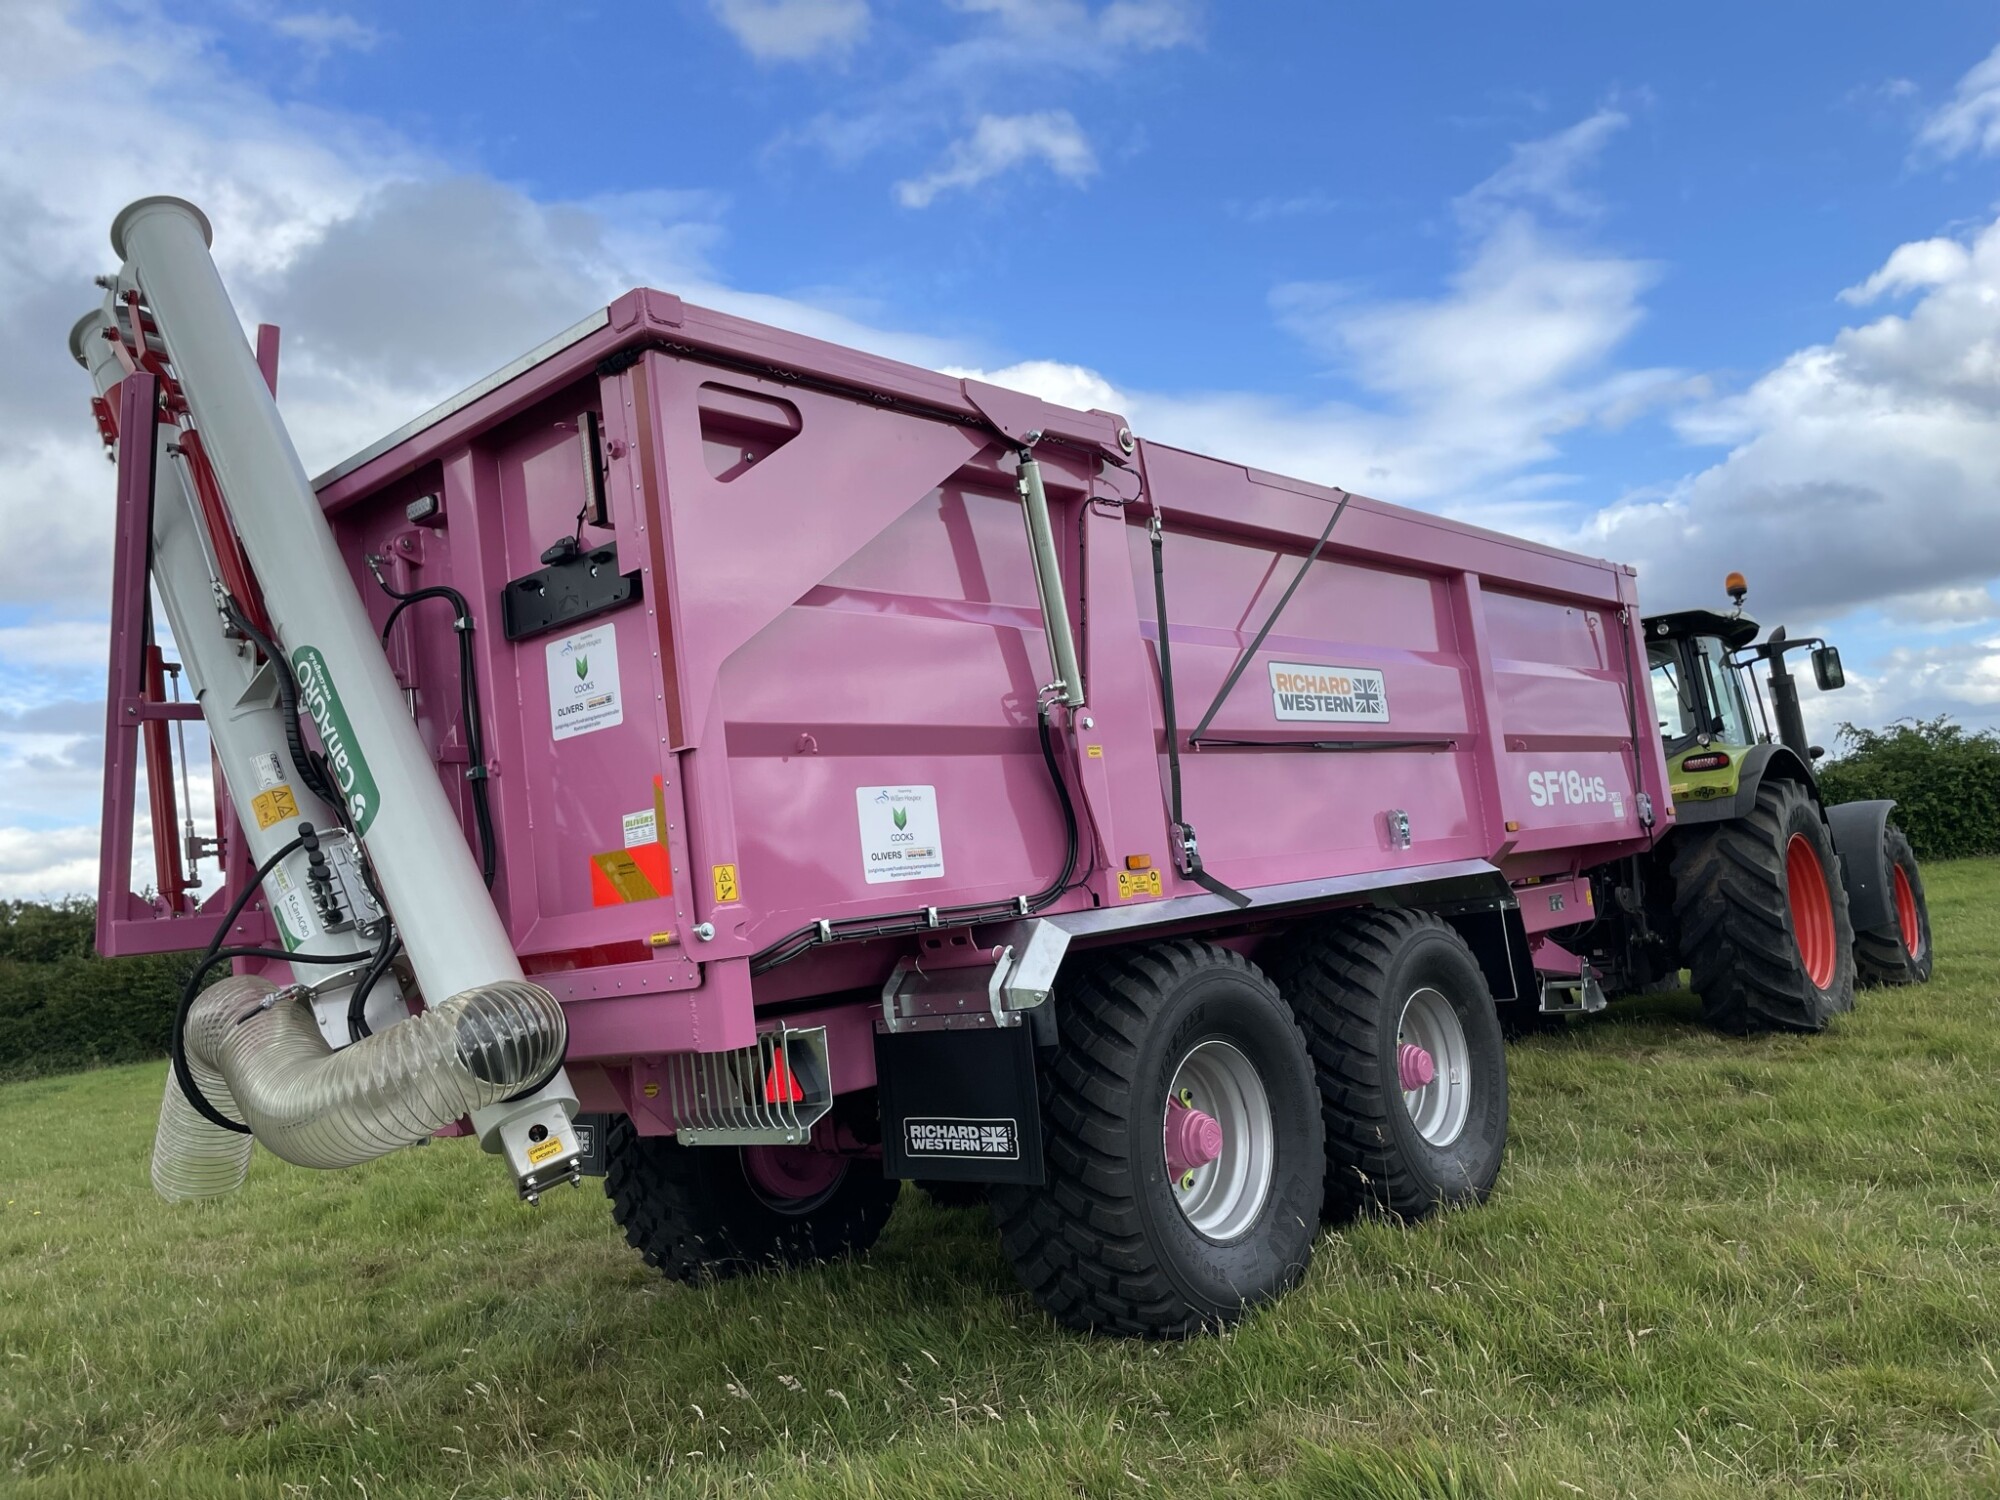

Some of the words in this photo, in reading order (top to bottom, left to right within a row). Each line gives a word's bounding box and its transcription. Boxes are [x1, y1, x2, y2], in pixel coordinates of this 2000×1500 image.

[574, 681, 594, 694] COOKS
[1275, 673, 1352, 695] RICHARD
[557, 703, 584, 717] OLIVERS
[1279, 694, 1355, 713] WESTERN
[297, 661, 355, 793] CanAGRO
[1528, 770, 1607, 807] SF18HS
[625, 815, 654, 828] OLIVERS
[891, 833, 914, 842] COOKS
[871, 851, 902, 861] OLIVERS
[291, 901, 310, 938] CanAGRO
[910, 1125, 980, 1139] RICHARD
[530, 1140, 559, 1155] GREASE
[911, 1139, 981, 1151] WESTERN
[536, 1148, 557, 1160] POINT
